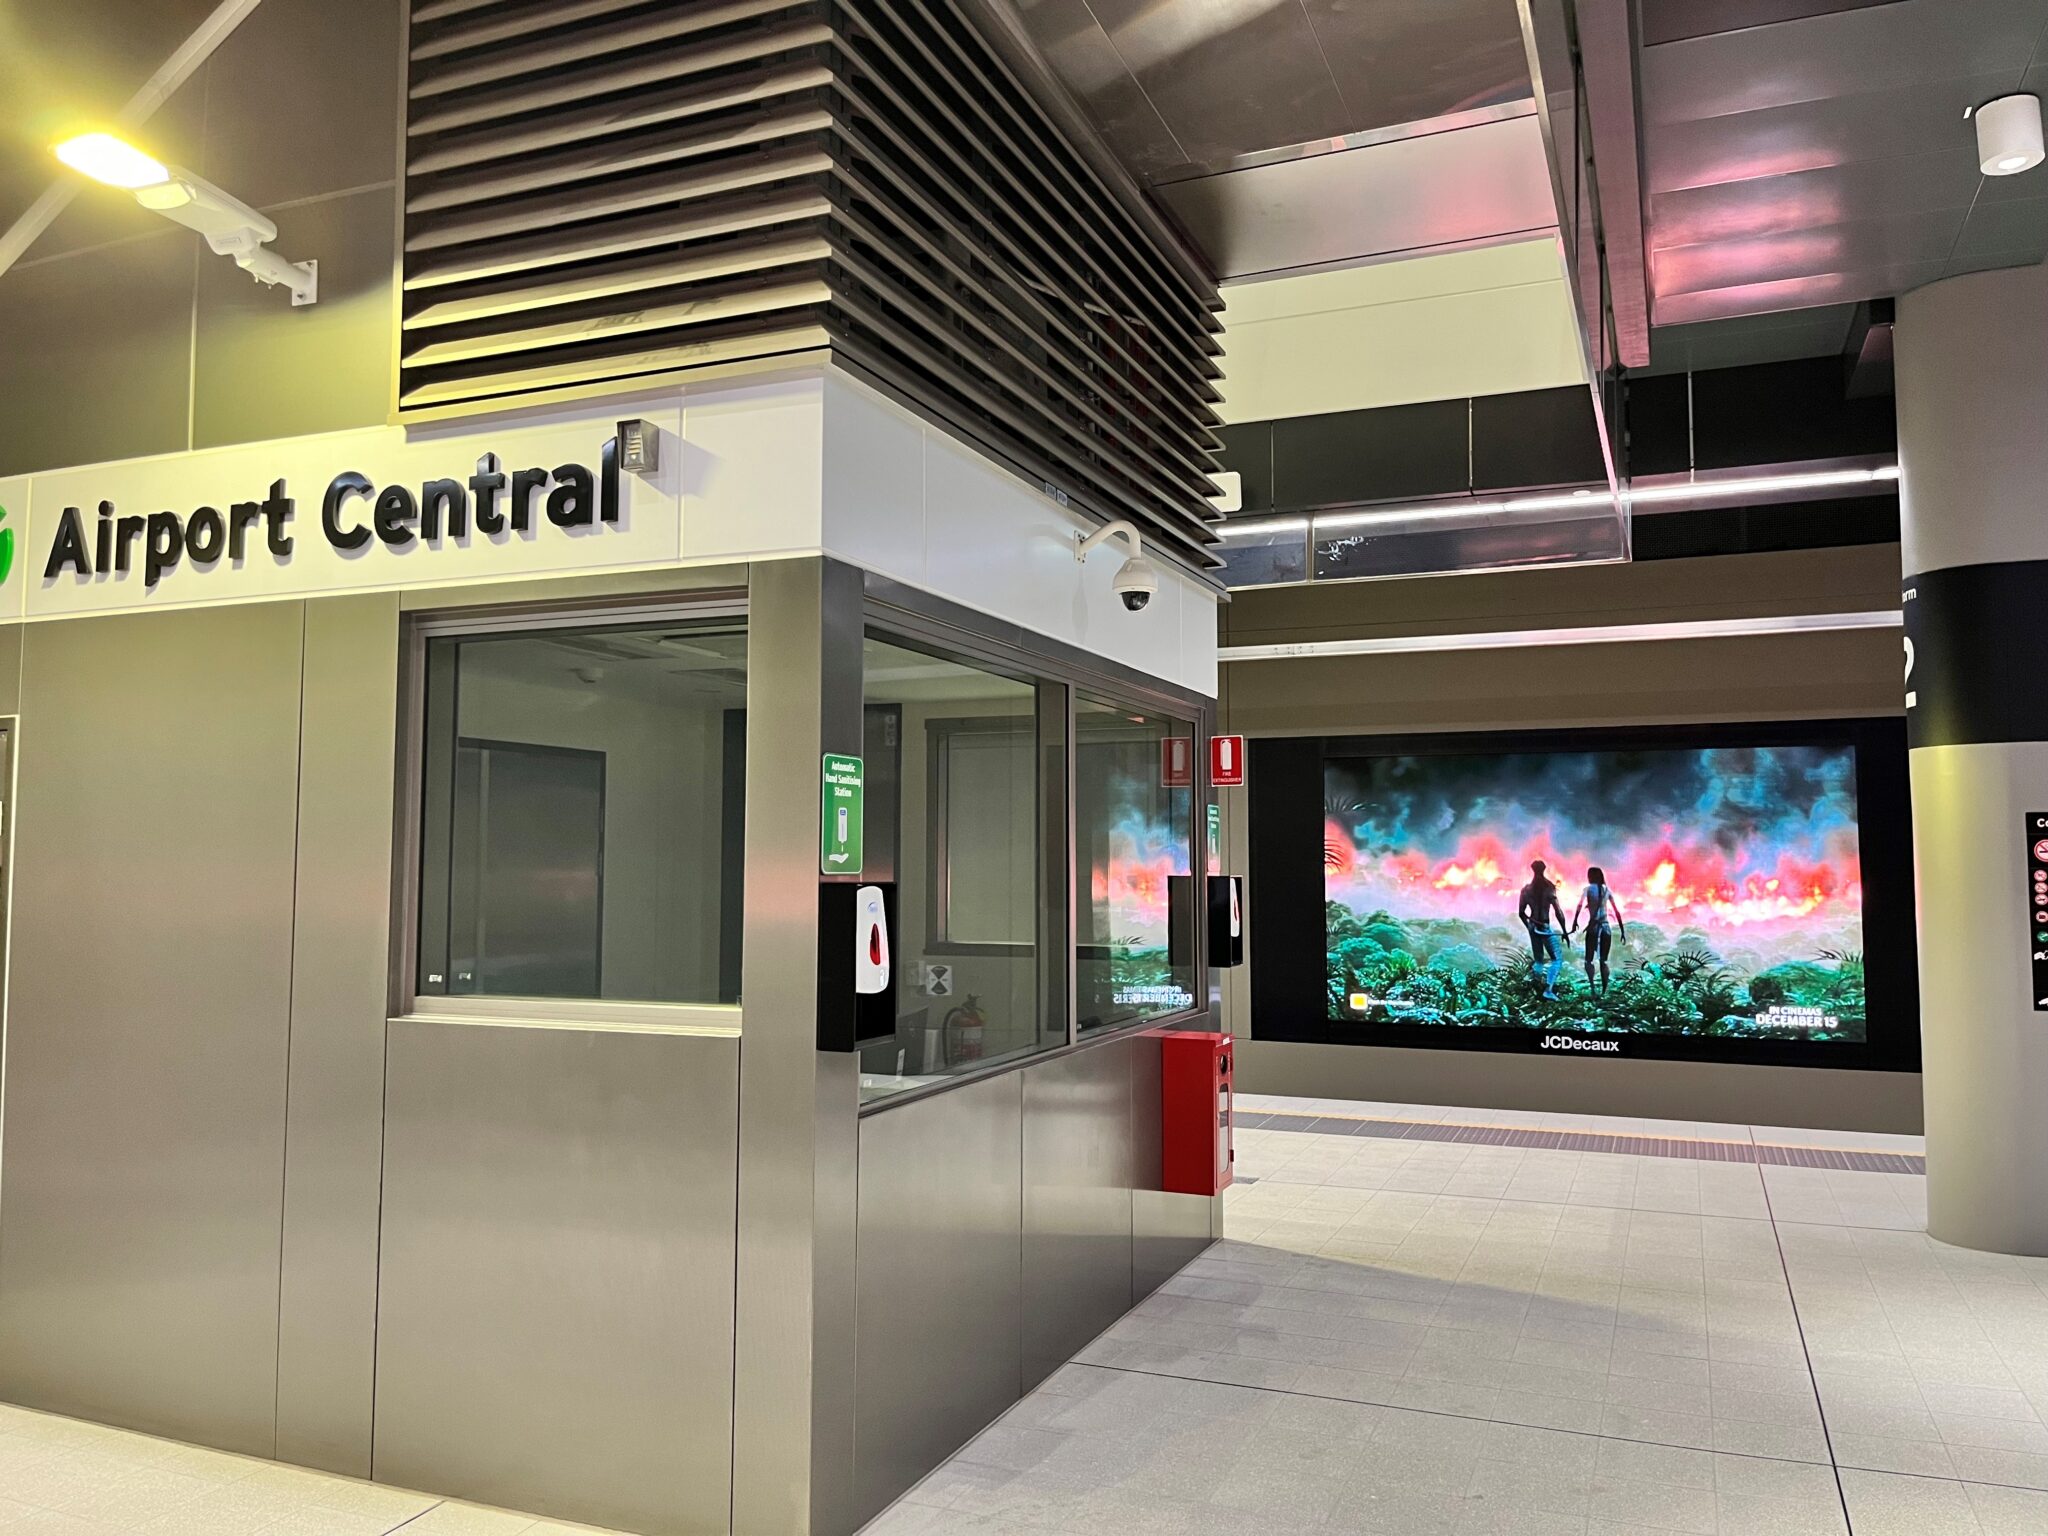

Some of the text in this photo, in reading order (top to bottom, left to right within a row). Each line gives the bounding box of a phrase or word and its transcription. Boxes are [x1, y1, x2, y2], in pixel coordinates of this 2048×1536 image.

[43, 436, 618, 587] Airport Central
[825, 773, 837, 783] Hand
[834, 787, 852, 797] Station
[1769, 1006, 1822, 1015] IN CINEMAS
[1755, 1014, 1839, 1029] DECEMBER 15
[1540, 1035, 1620, 1052] JCDecaux
